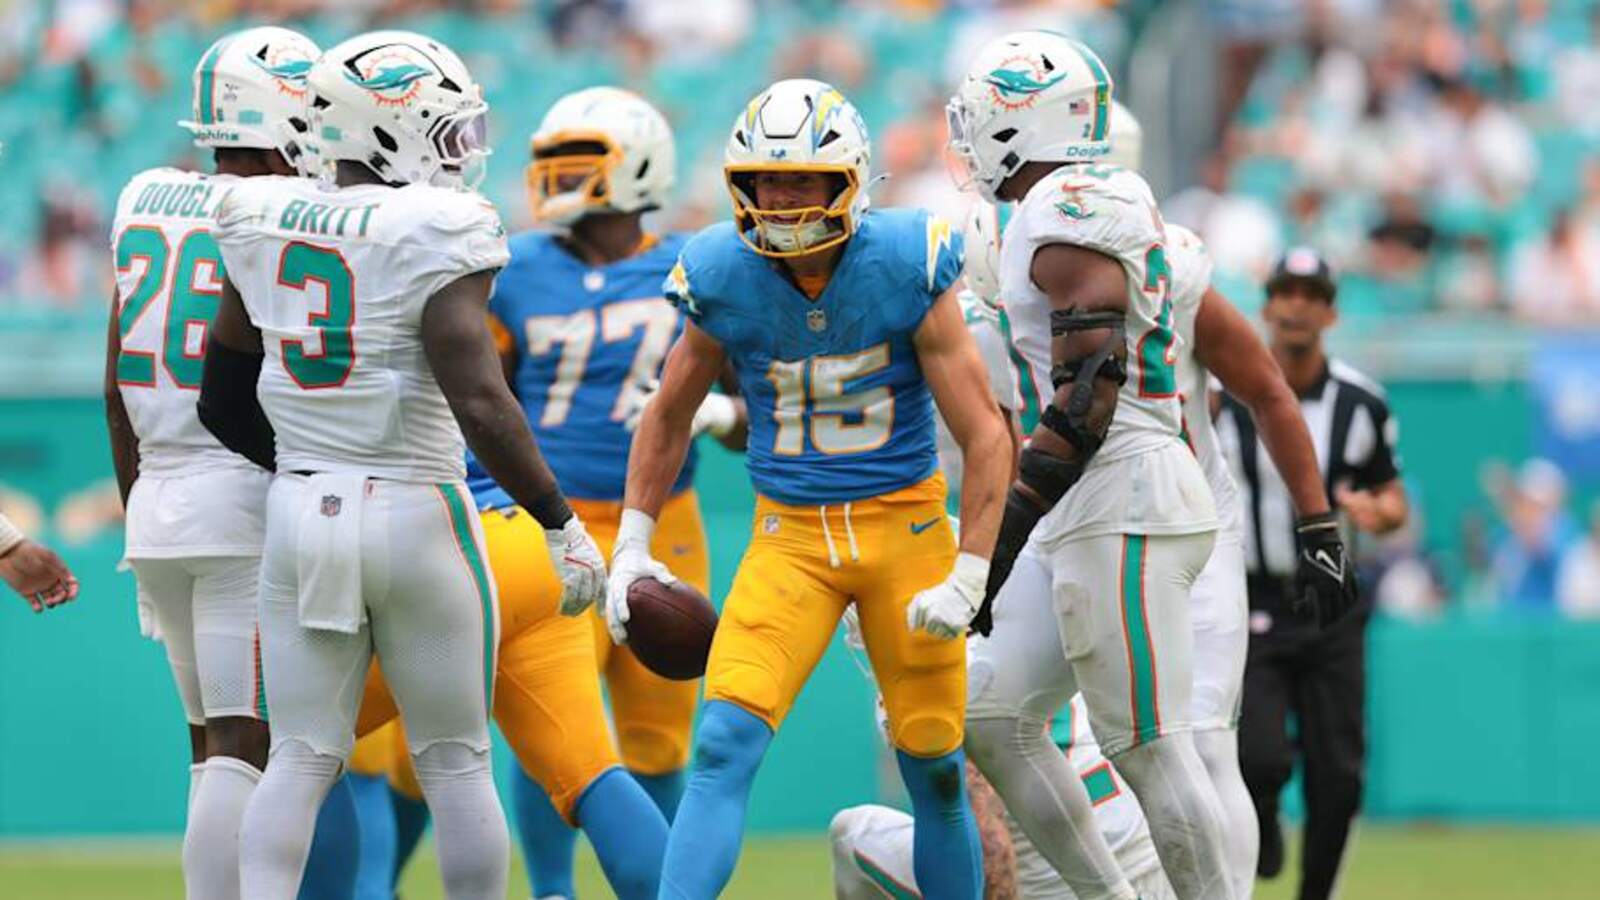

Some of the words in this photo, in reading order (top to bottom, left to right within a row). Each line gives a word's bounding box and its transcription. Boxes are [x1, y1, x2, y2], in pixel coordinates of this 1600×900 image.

[279, 199, 380, 236] BRITT
[117, 225, 224, 390] 26
[277, 240, 355, 390] 3
[526, 298, 678, 428] 77
[765, 341, 894, 455] 15
